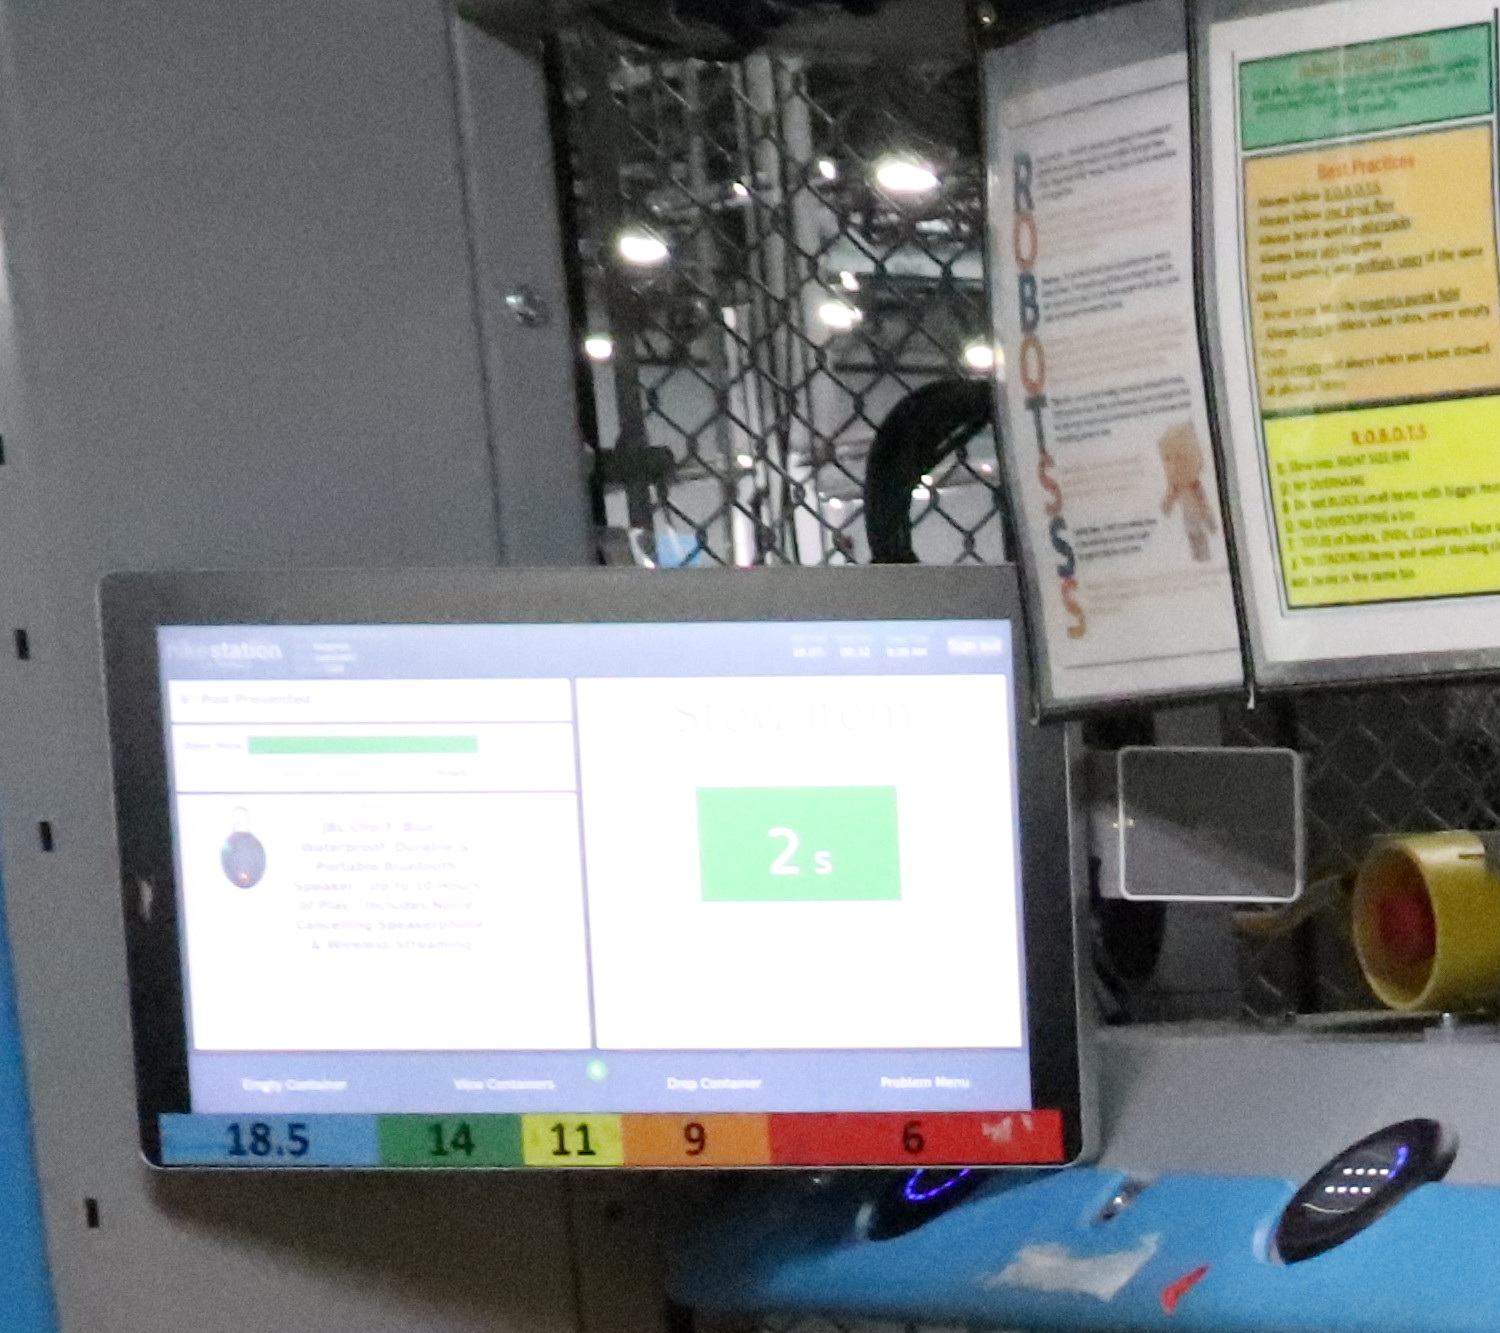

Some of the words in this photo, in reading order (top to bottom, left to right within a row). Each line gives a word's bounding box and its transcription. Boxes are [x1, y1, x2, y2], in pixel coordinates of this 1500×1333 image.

[768, 826, 800, 875] 2
[813, 851, 834, 875] s
[700, 1075, 763, 1090] Container
[880, 1074, 933, 1090] Problem
[934, 1074, 970, 1090] Menu
[226, 1122, 310, 1157] 18.5
[428, 1122, 477, 1157] 14
[550, 1122, 598, 1157] 11
[683, 1121, 707, 1157] 9
[902, 1120, 924, 1155] 6
